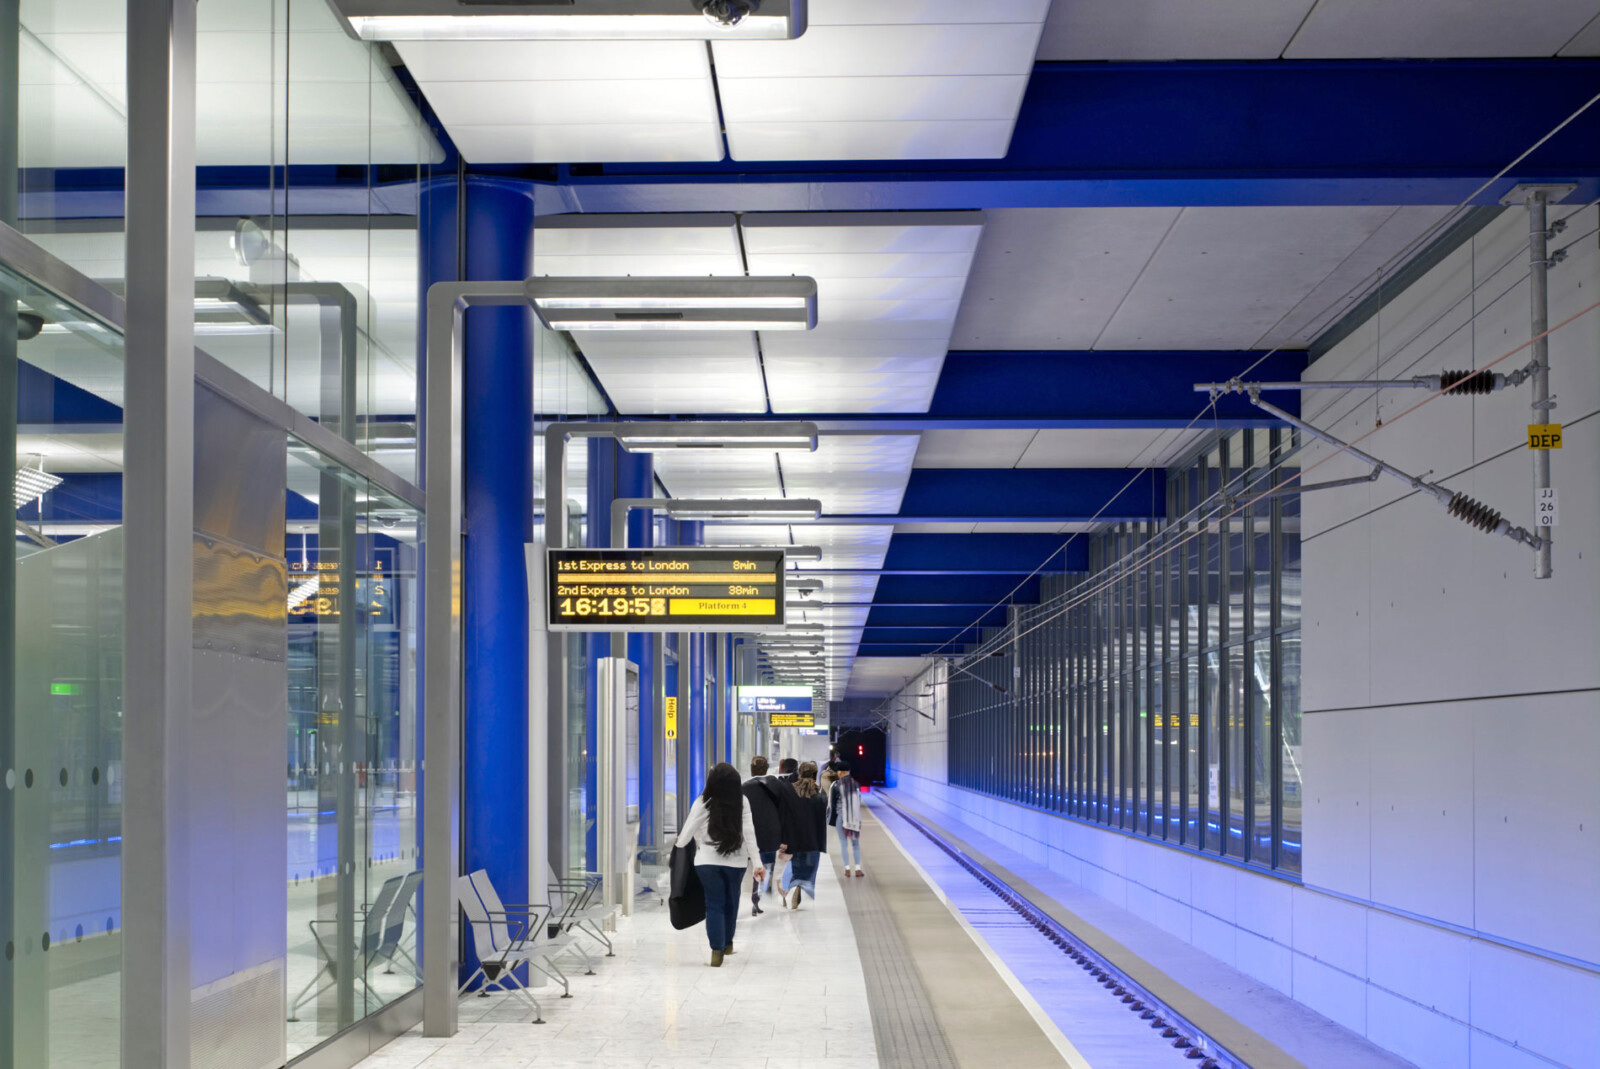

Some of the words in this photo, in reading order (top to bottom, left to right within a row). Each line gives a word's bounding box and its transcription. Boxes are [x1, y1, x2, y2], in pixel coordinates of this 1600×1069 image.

[1530, 434, 1561, 448] DEP
[1542, 489, 1553, 498] JJ
[1540, 502, 1554, 512] 26
[557, 560, 578, 570] 1st
[579, 560, 627, 572] Express
[631, 561, 645, 570] to
[648, 560, 690, 570] London
[732, 560, 757, 570] 8min
[557, 585, 579, 596] 2nd
[580, 585, 627, 597] Express
[631, 586, 646, 596] to
[648, 585, 690, 596] London
[728, 585, 759, 596] 38min
[698, 601, 740, 610] Platform
[741, 601, 747, 609] 4
[666, 698, 676, 719] Help
